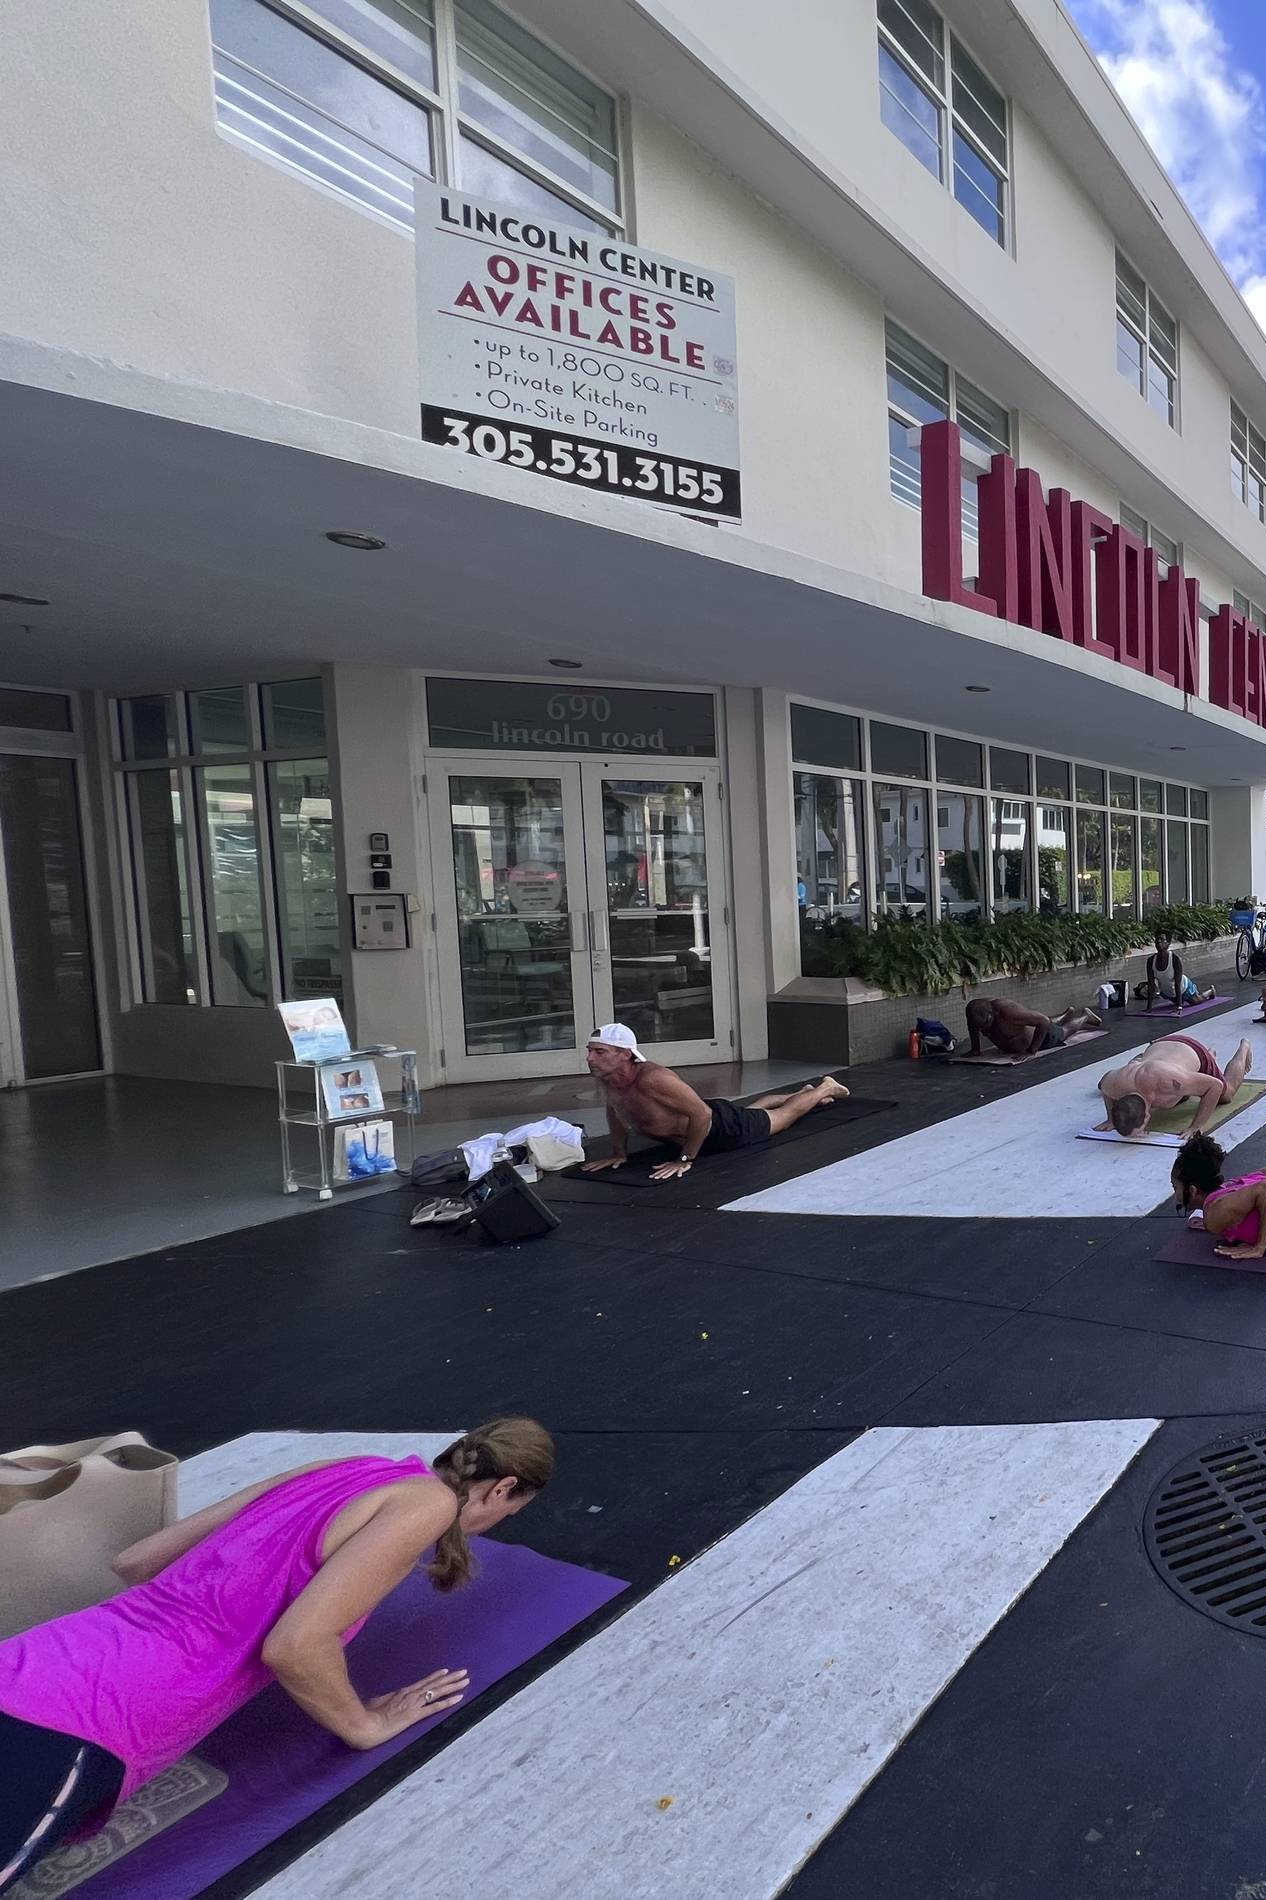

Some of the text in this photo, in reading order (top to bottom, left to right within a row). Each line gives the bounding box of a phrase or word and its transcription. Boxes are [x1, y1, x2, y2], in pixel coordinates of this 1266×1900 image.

[440, 197, 715, 302] LINCOLN CENTER
[454, 280, 706, 370] AVAILABLE
[487, 254, 677, 331] OFFICES
[485, 340, 694, 401] up to 1,800 SQ. FT.
[487, 361, 648, 415] Private Kitchen
[487, 389, 659, 447] On-Site Parking
[442, 416, 724, 504] 305.531.3155
[921, 419, 1200, 697] LINCOLN
[492, 720, 667, 750] lincoln road
[546, 693, 611, 722] 690
